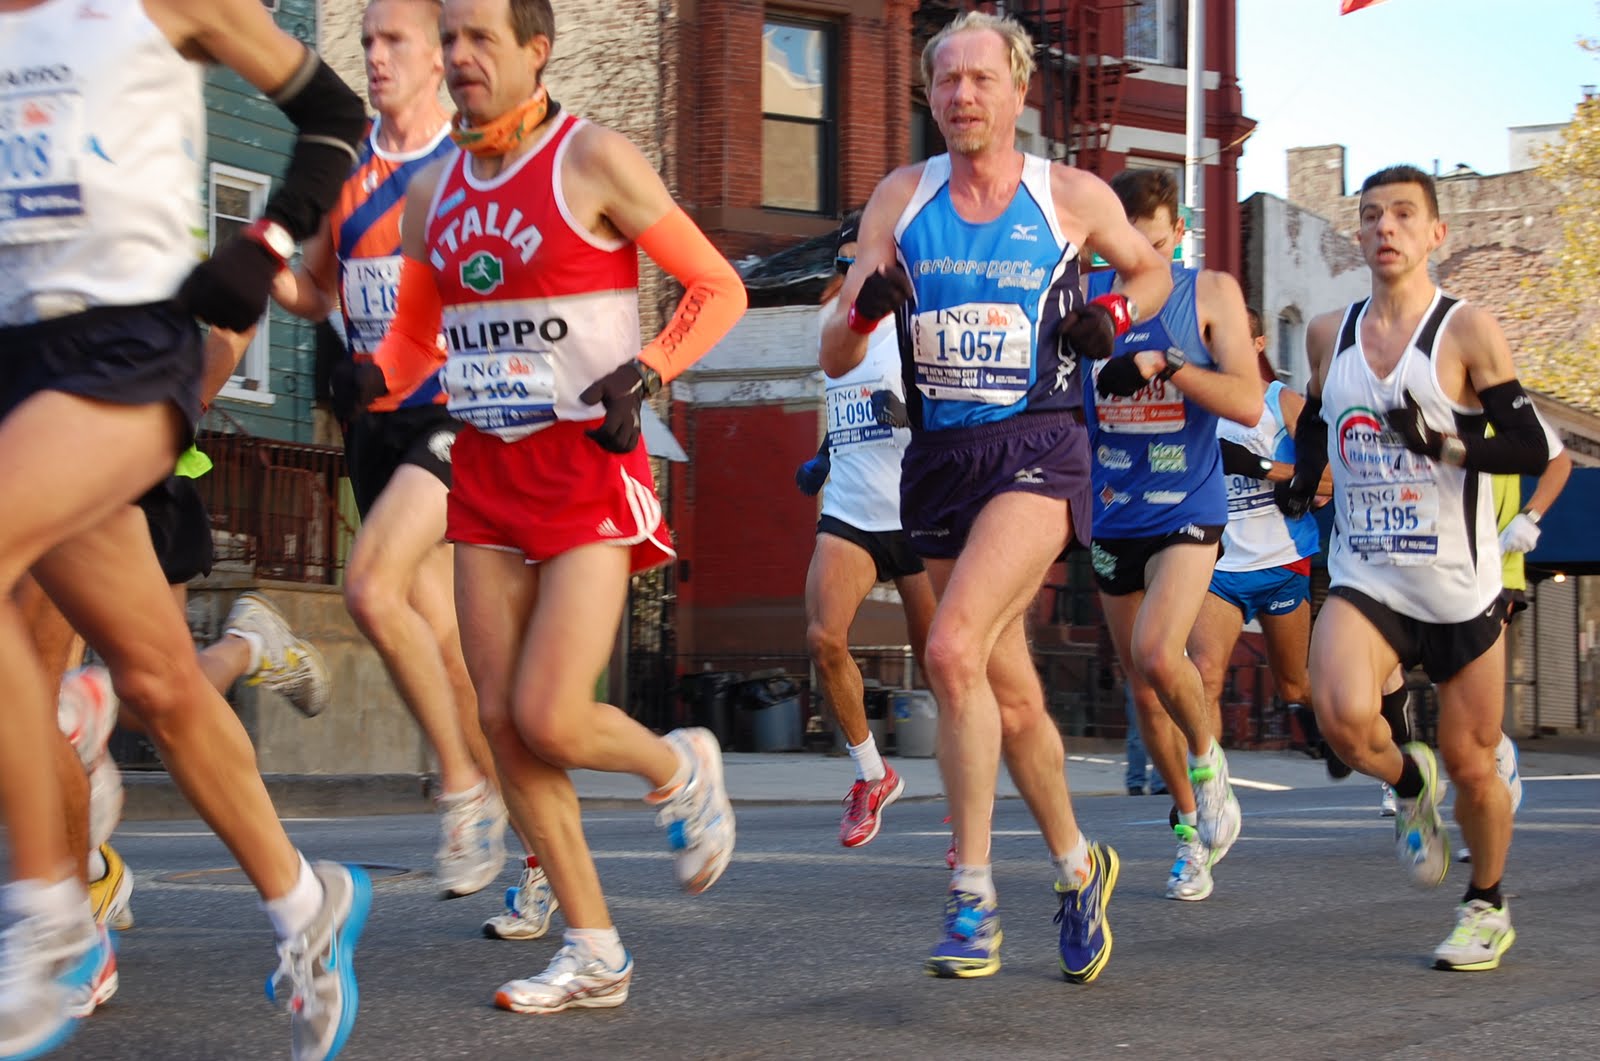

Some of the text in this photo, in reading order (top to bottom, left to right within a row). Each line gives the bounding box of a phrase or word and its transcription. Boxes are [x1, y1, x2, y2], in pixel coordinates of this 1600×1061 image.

[429, 202, 543, 272] ITALIA
[357, 266, 392, 281] ING
[936, 310, 979, 325] ING
[443, 318, 568, 351] ILIPPO
[936, 330, 1007, 362] 1-057
[462, 360, 501, 378] ING
[962, 369, 978, 379] CITY
[835, 389, 857, 402] ING
[834, 401, 874, 427] 1-090
[1361, 489, 1395, 504] ING
[1365, 505, 1419, 532] 1-195
